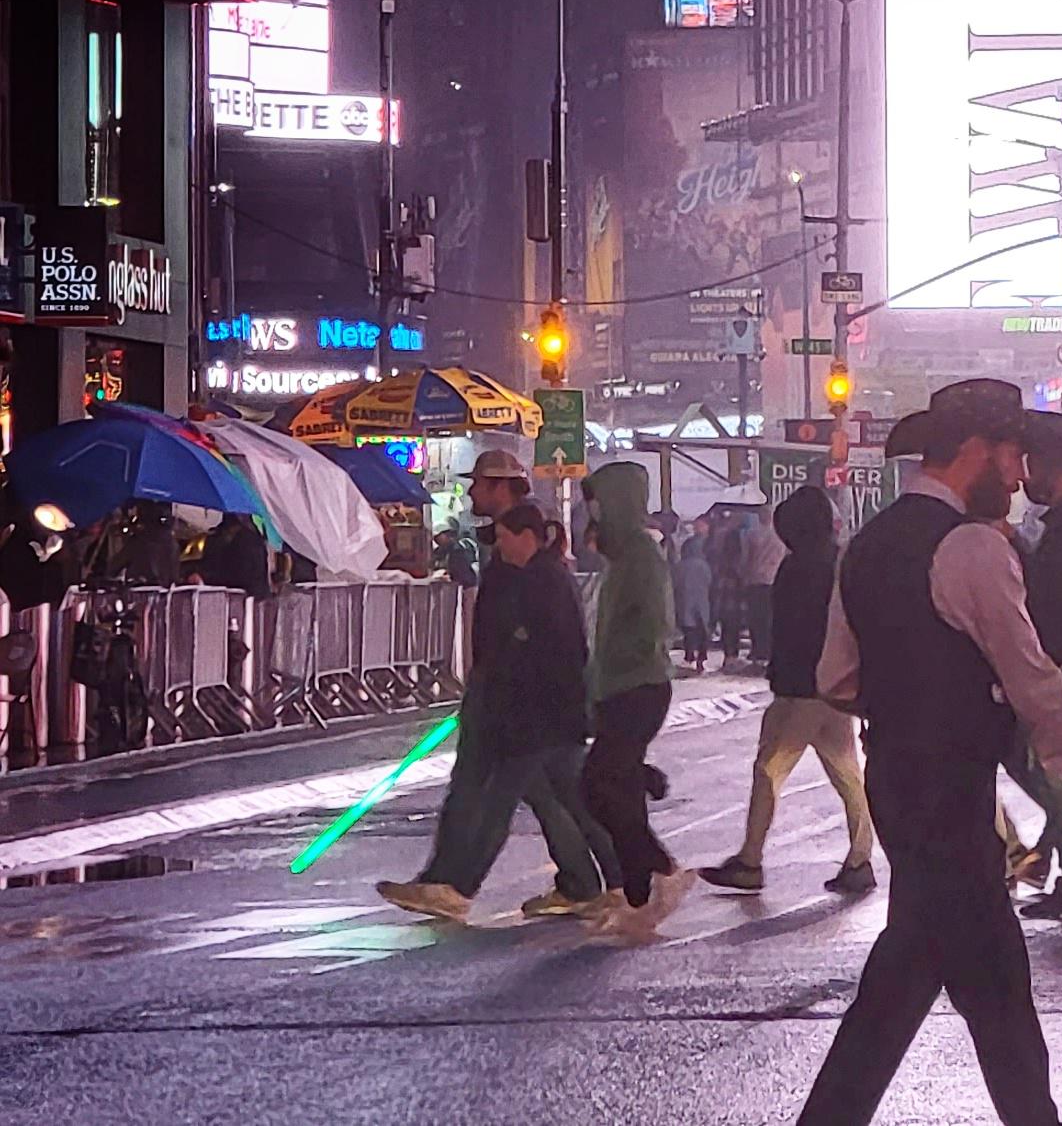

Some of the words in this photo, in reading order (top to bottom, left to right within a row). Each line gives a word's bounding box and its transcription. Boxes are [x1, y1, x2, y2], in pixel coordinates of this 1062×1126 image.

[41, 247, 78, 263] U.S.
[41, 265, 97, 282] POLO
[149, 249, 171, 315] hut
[40, 283, 101, 301] ASSN.
[349, 406, 409, 423] SABRETT
